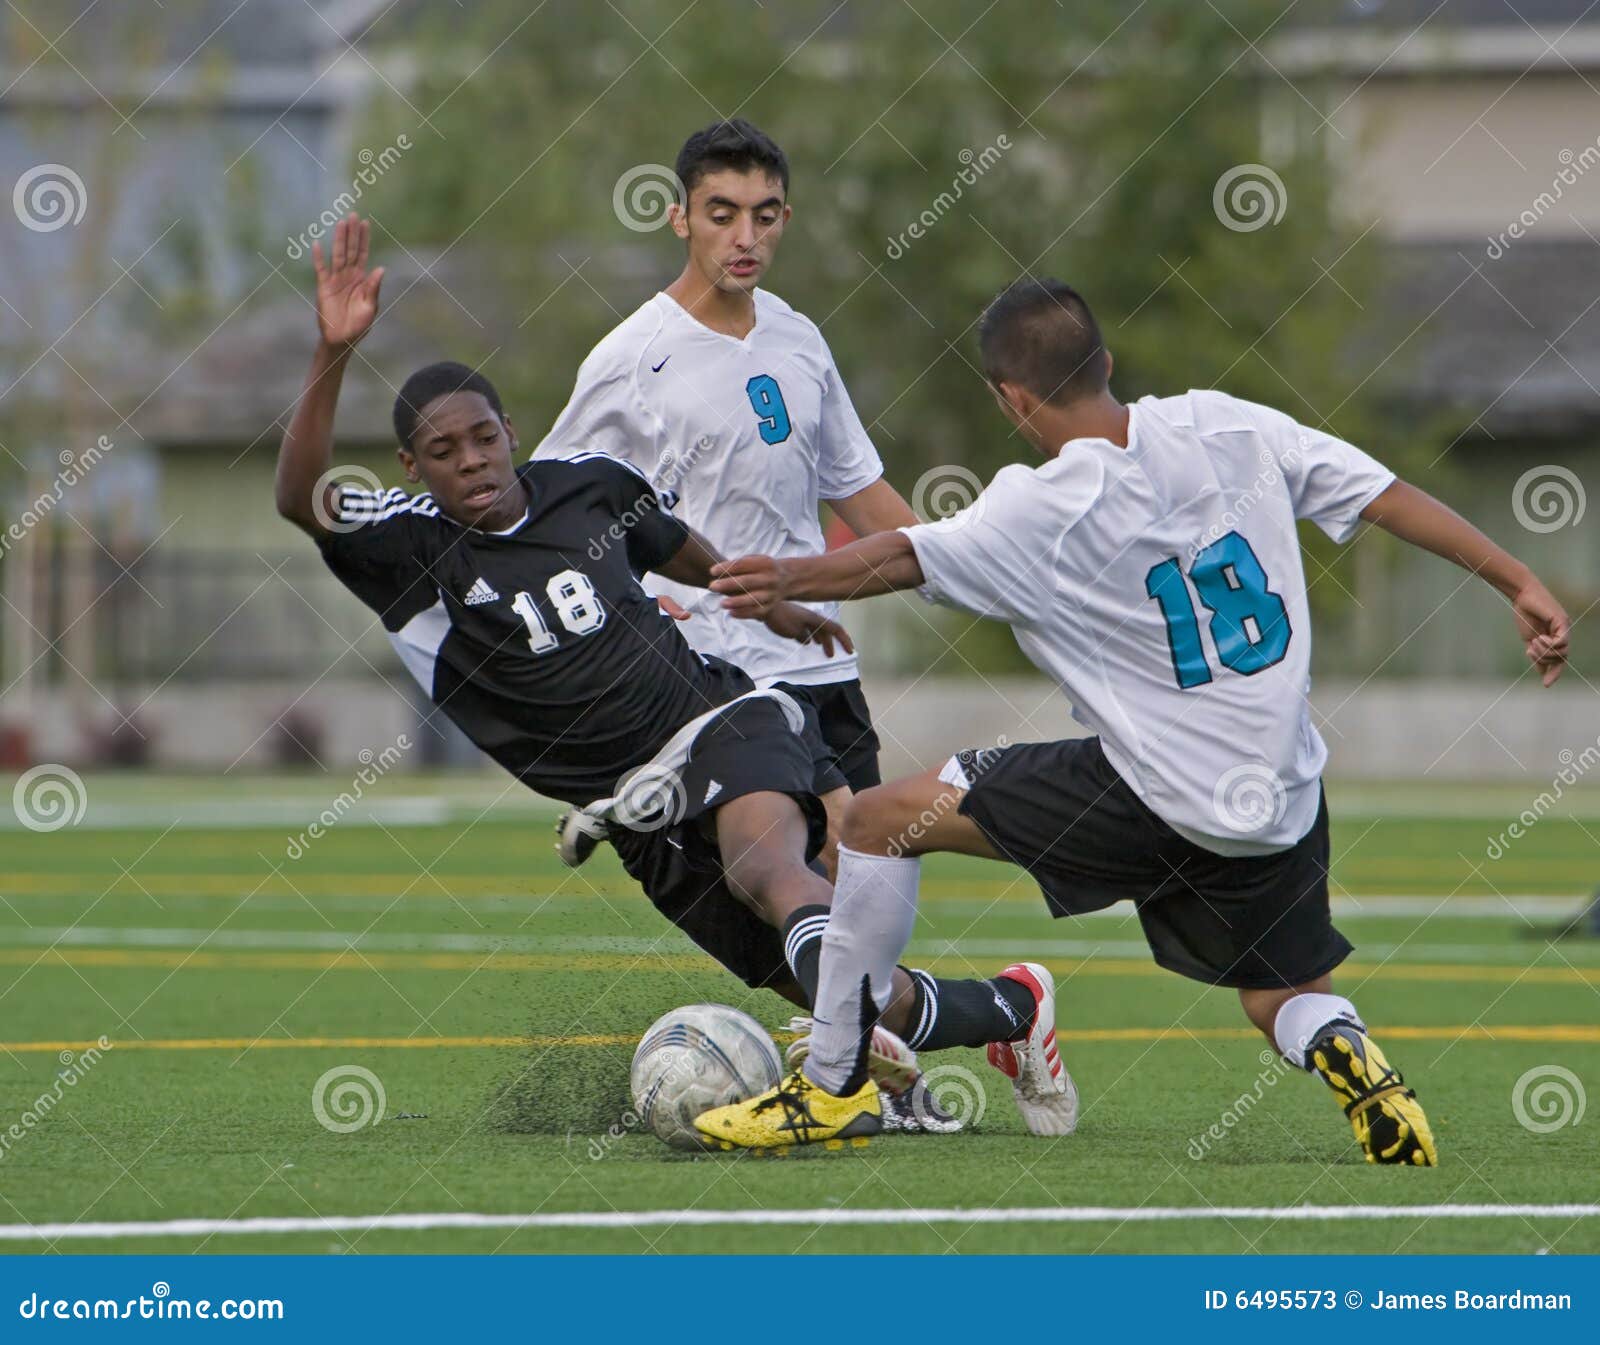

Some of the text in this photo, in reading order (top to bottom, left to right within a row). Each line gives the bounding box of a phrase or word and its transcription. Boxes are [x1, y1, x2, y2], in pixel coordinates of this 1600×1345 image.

[746, 374, 792, 446] 9
[464, 592, 500, 606] adidas
[511, 569, 606, 654] 18
[1145, 530, 1293, 690] 18
